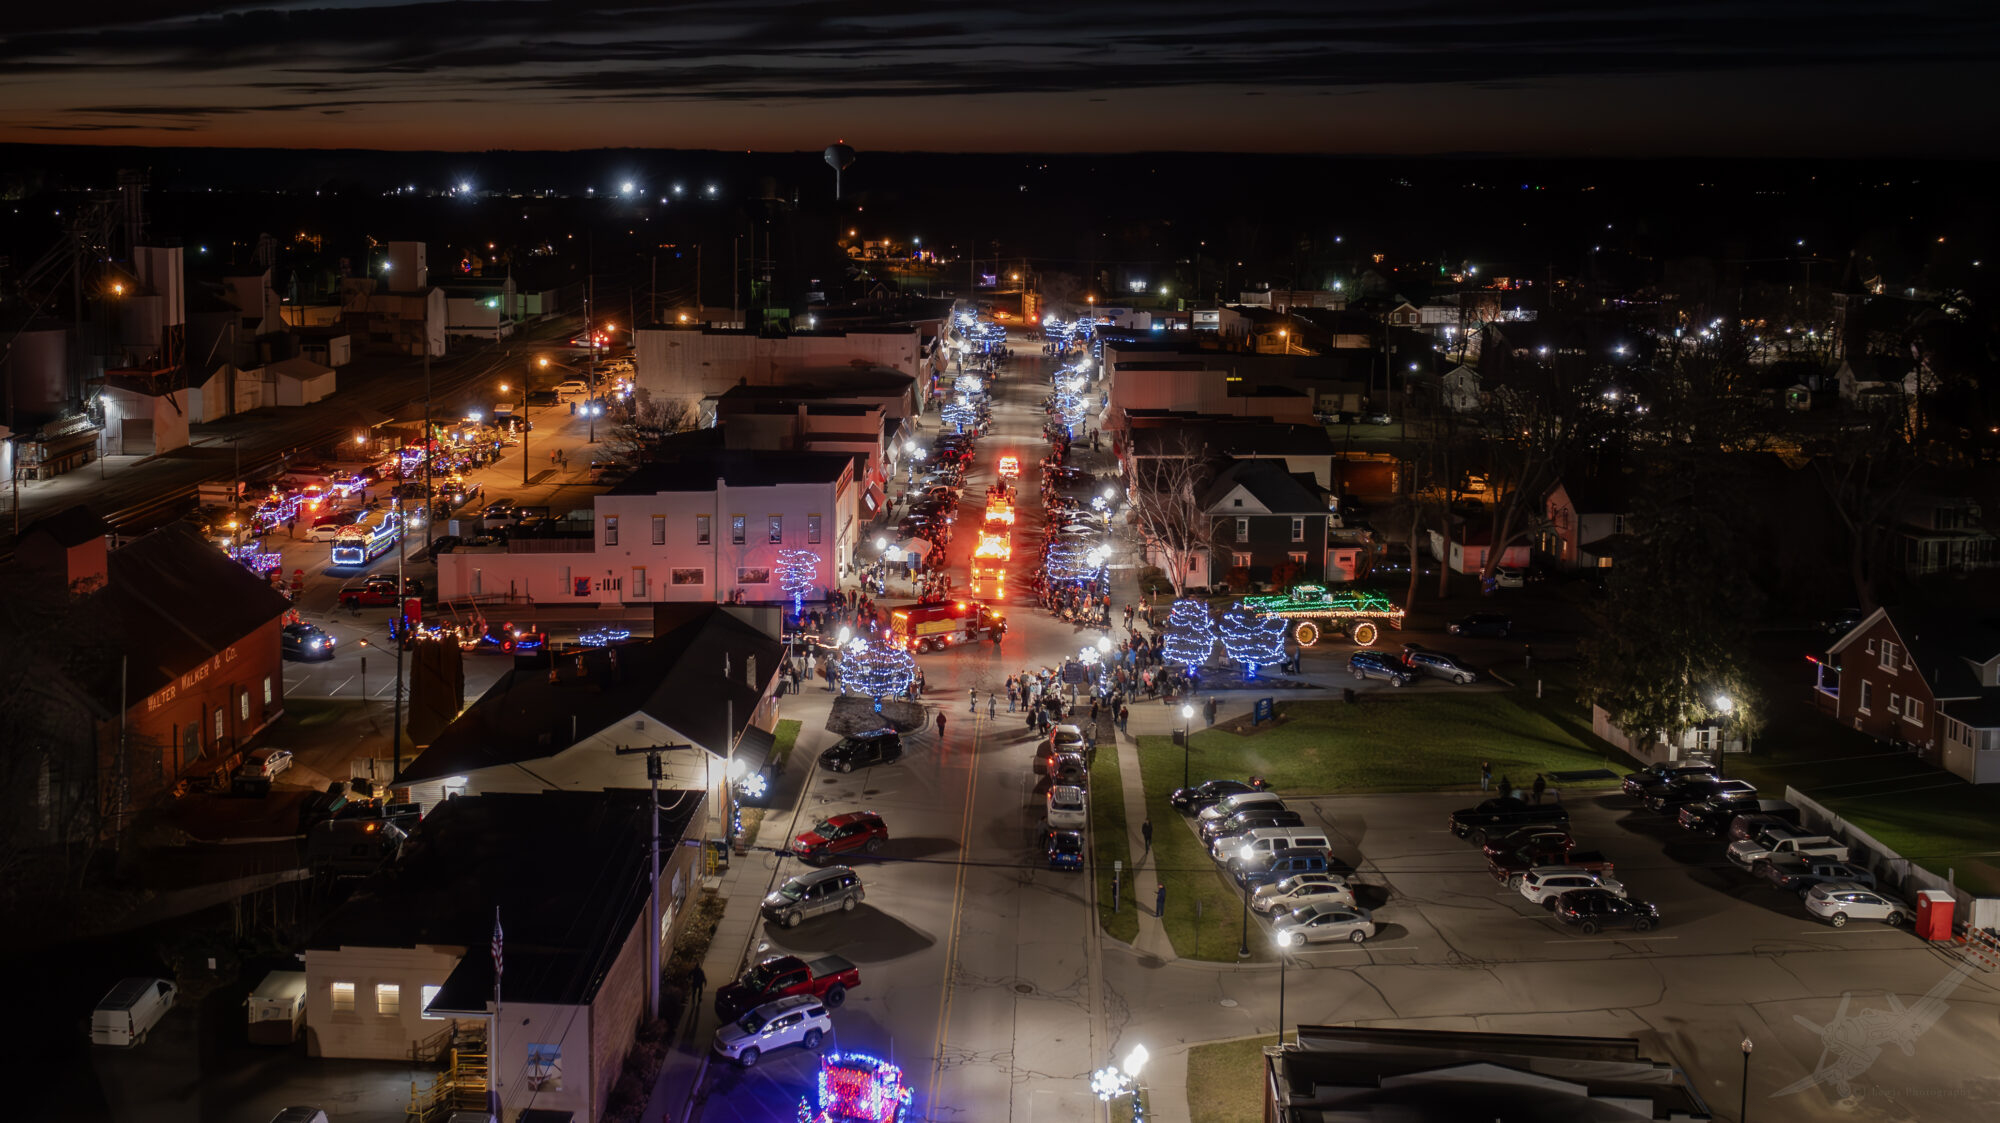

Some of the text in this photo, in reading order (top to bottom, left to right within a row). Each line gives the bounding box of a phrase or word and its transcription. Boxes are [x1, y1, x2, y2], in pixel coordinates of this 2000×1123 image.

[147, 687, 176, 712] WALTER
[181, 664, 209, 690] WALKER
[214, 654, 221, 670] &
